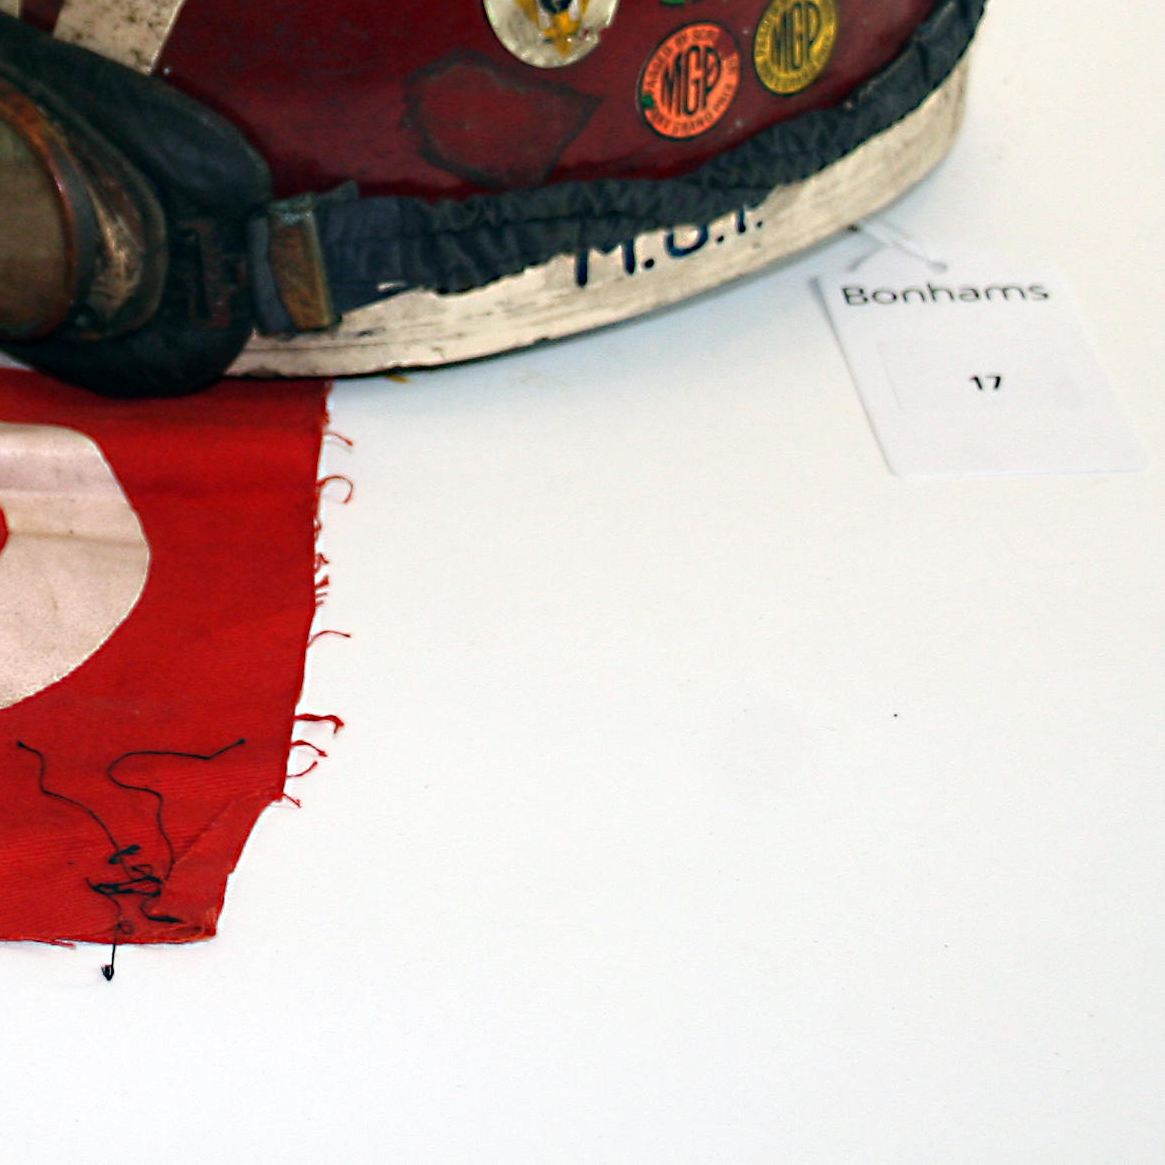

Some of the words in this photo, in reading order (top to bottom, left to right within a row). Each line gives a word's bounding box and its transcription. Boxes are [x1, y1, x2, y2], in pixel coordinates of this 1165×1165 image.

[770, 0, 823, 73] MGP
[659, 44, 723, 117] MGP
[842, 280, 1050, 308] Bonhams
[969, 374, 1002, 392] 17
